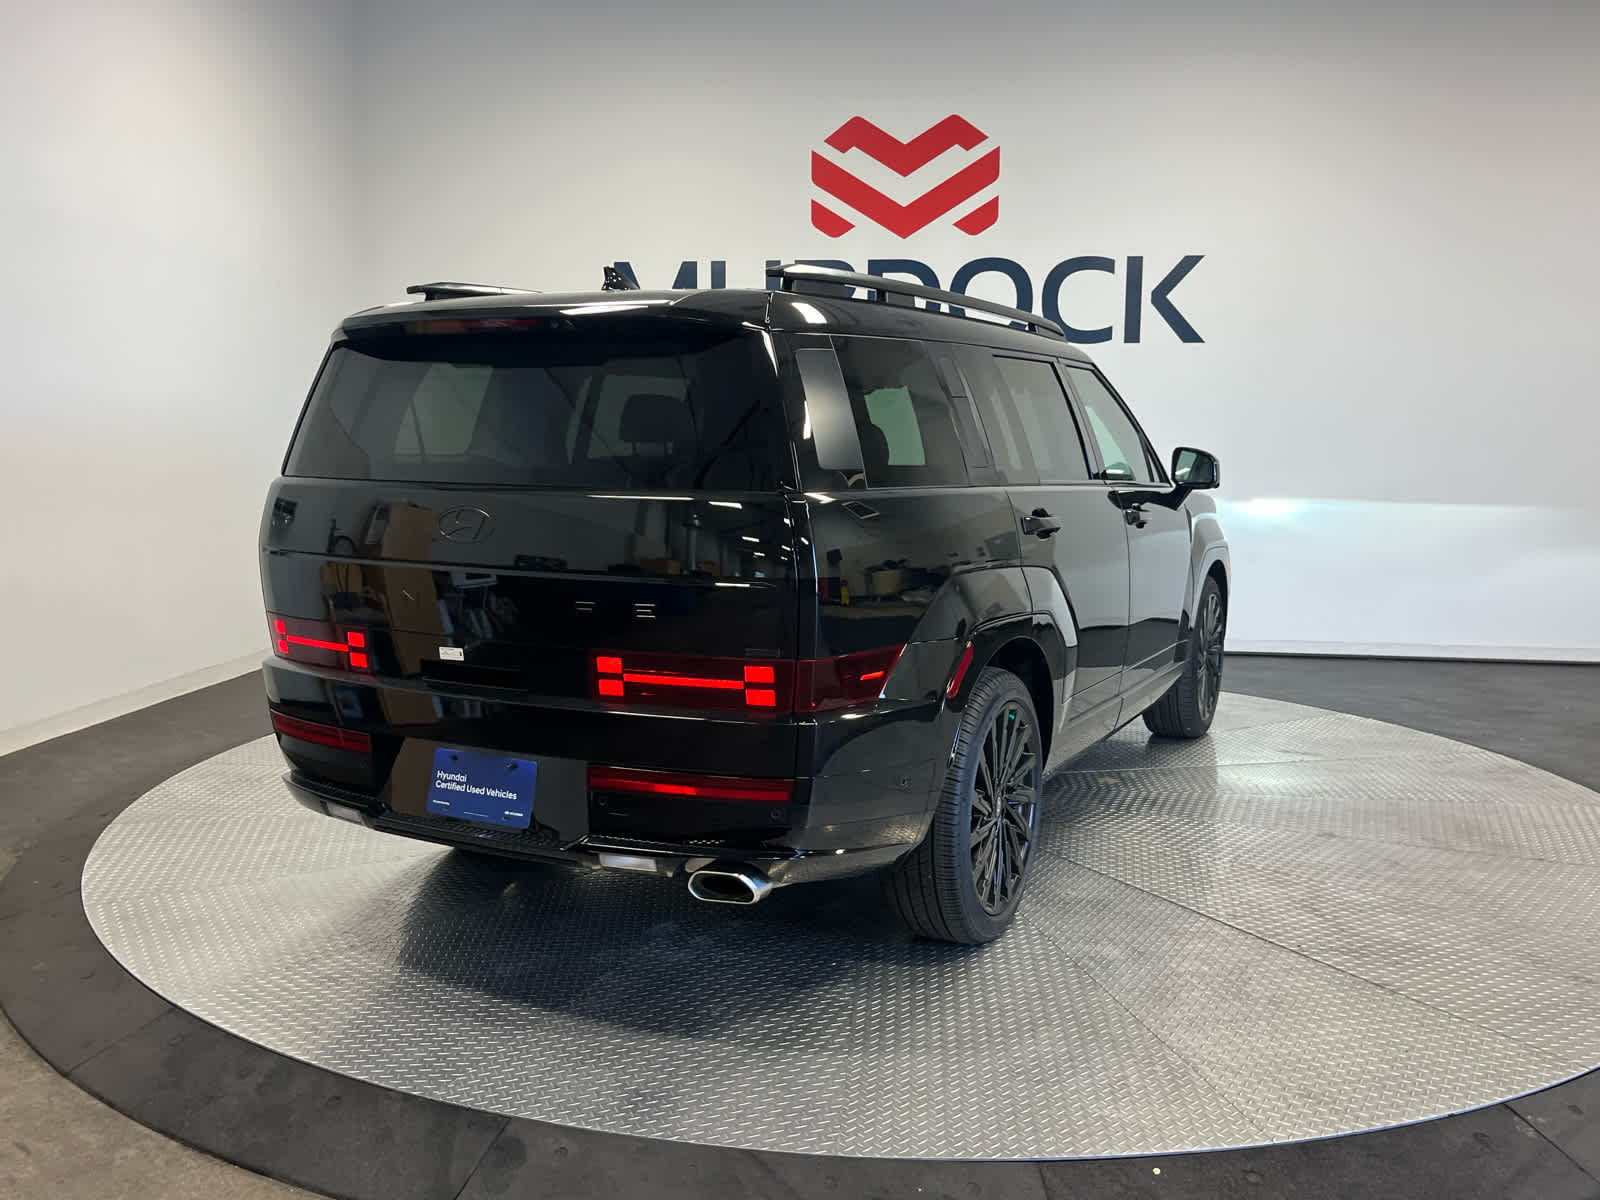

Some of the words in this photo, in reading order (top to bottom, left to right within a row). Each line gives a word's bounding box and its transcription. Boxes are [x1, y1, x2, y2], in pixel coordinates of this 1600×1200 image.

[612, 256, 1206, 344] DOCK
[437, 770, 467, 782] Hyundai
[435, 780, 466, 792] Certified
[466, 785, 486, 796] Used
[486, 788, 518, 800] Vehicles
